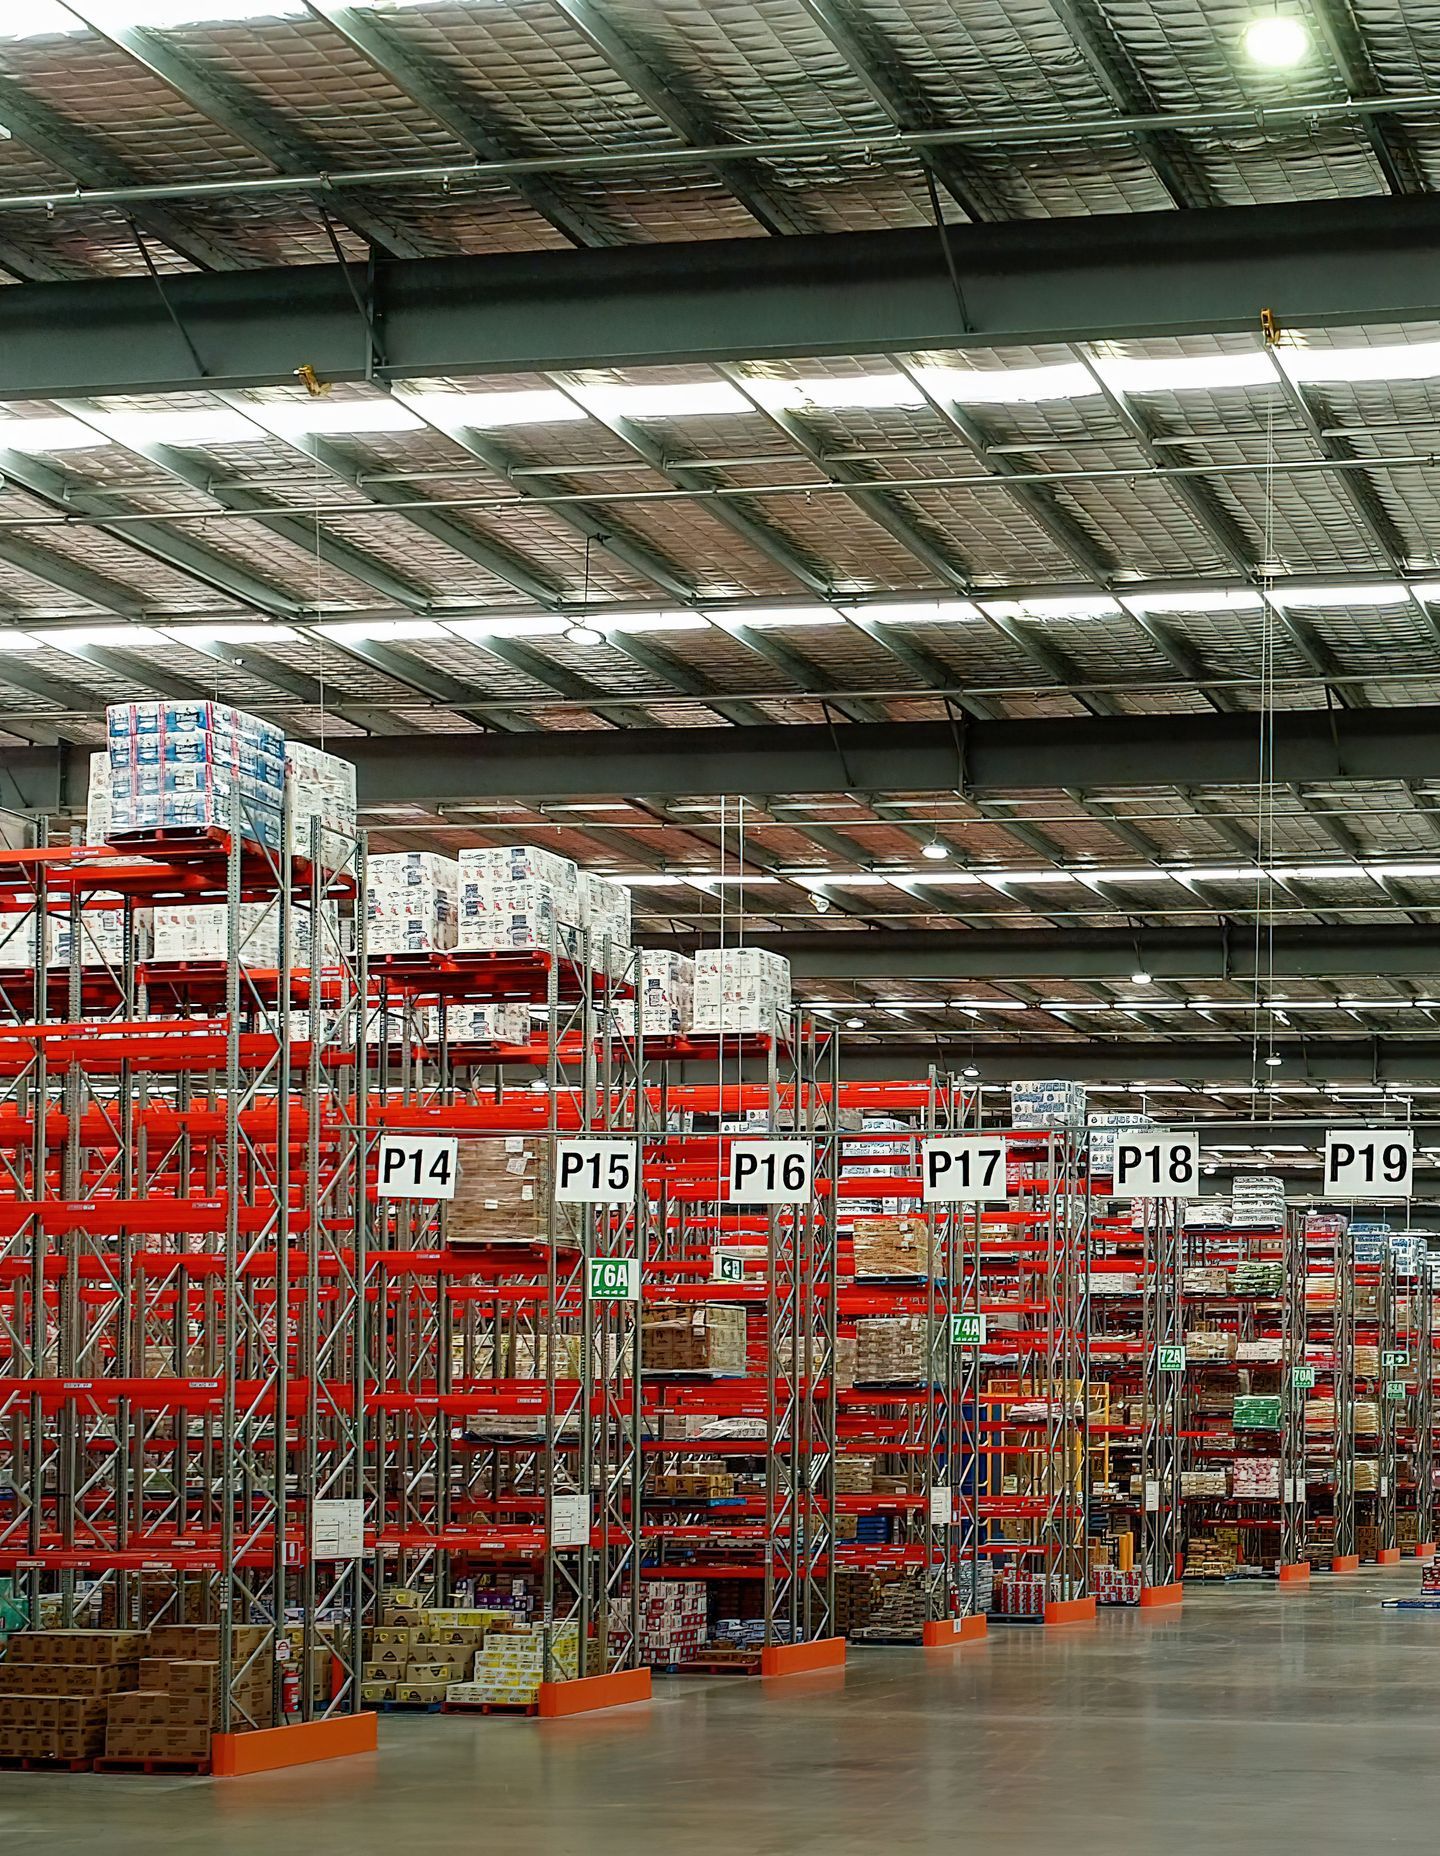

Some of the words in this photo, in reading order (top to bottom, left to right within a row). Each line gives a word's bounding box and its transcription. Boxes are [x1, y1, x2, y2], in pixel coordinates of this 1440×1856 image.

[383, 1147, 451, 1186] P14
[560, 1152, 630, 1190] P15
[735, 1153, 805, 1191] P16
[928, 1149, 1001, 1188] P17
[1117, 1144, 1193, 1184] P18
[1330, 1144, 1408, 1182] P19
[592, 1264, 628, 1287] 76A
[953, 1318, 980, 1336] 74A
